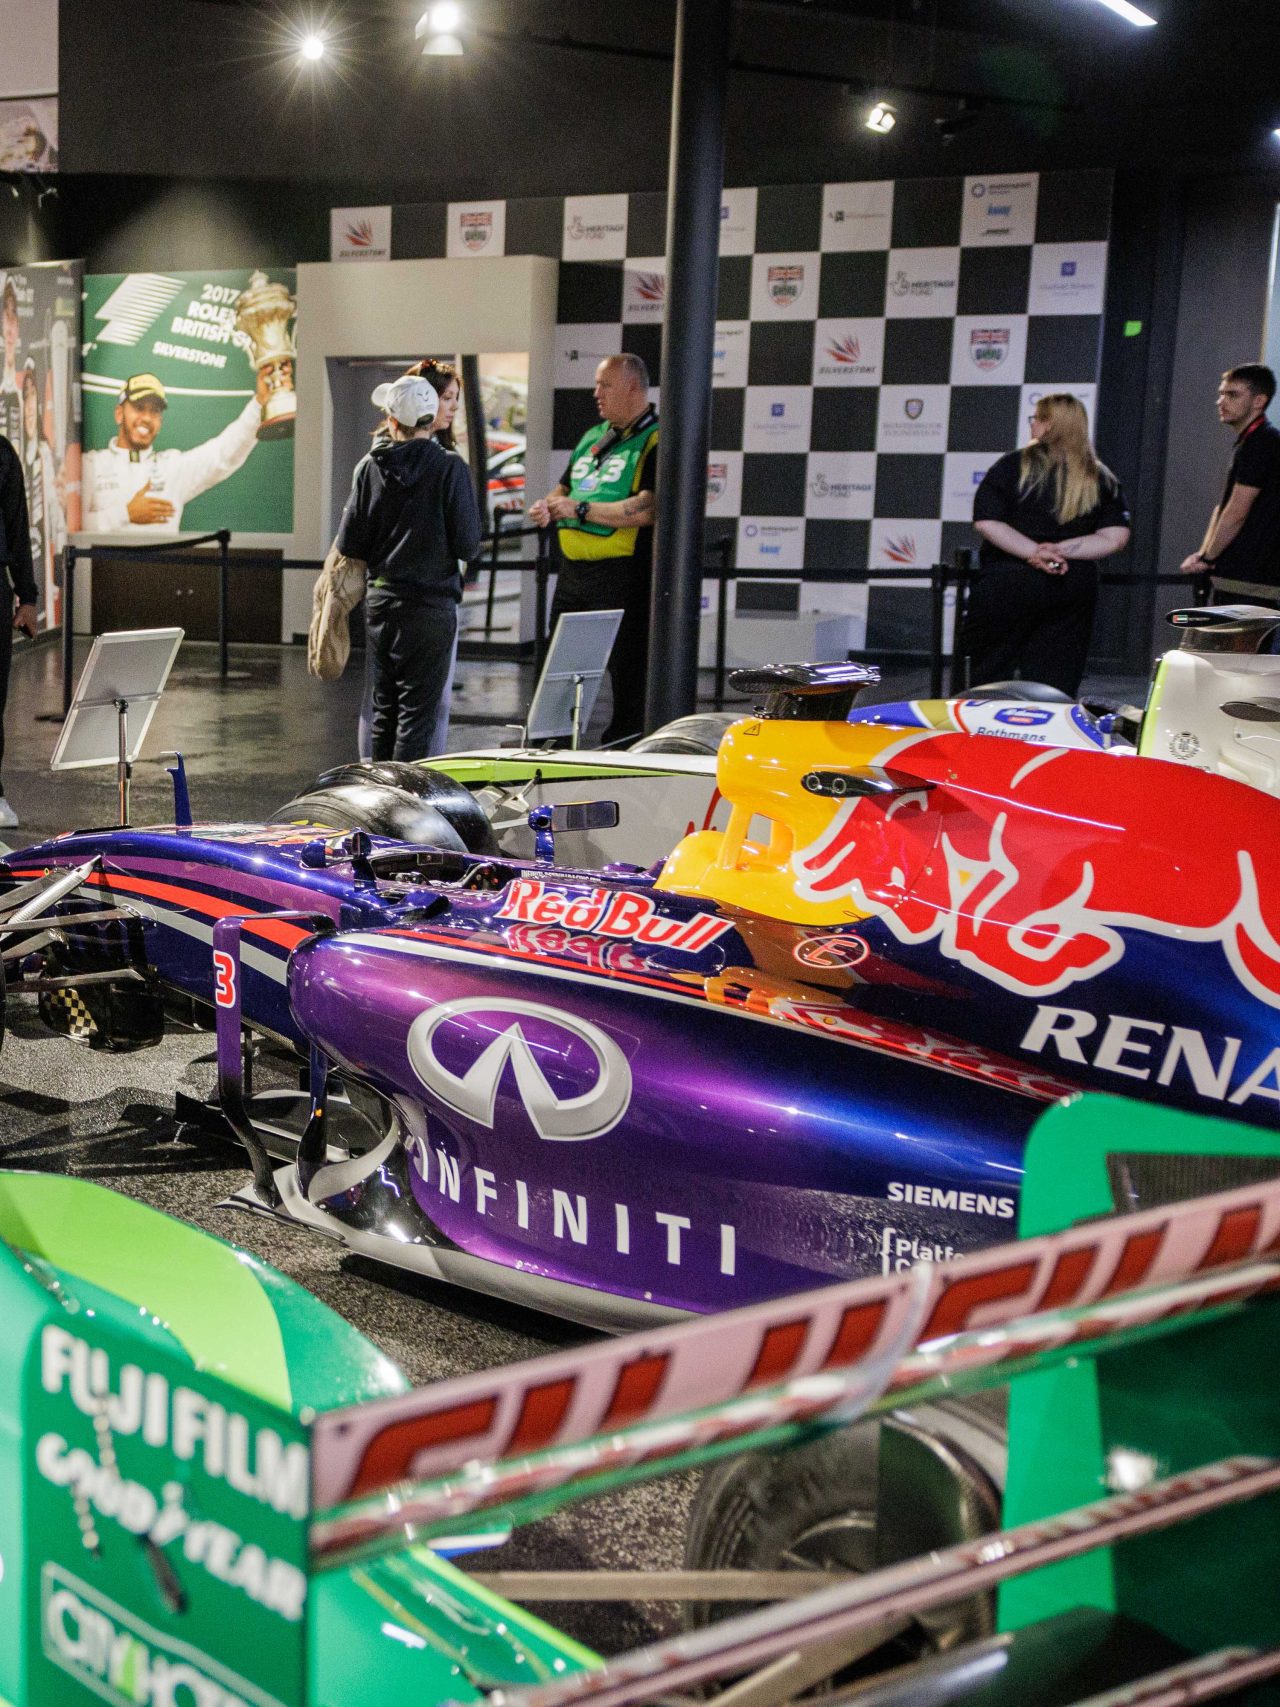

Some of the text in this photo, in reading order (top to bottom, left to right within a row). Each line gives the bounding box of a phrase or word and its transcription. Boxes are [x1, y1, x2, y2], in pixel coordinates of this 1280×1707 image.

[200, 283, 241, 305] 2017
[170, 316, 231, 344] BRITISH
[151, 340, 227, 369] SILVERSTONE
[976, 726, 1047, 742] Rothmans
[496, 879, 737, 953] Red Bull
[214, 950, 236, 1008] 3
[886, 1181, 1016, 1219] SIEMENS
[40, 1324, 310, 1521] FUJIFILM
